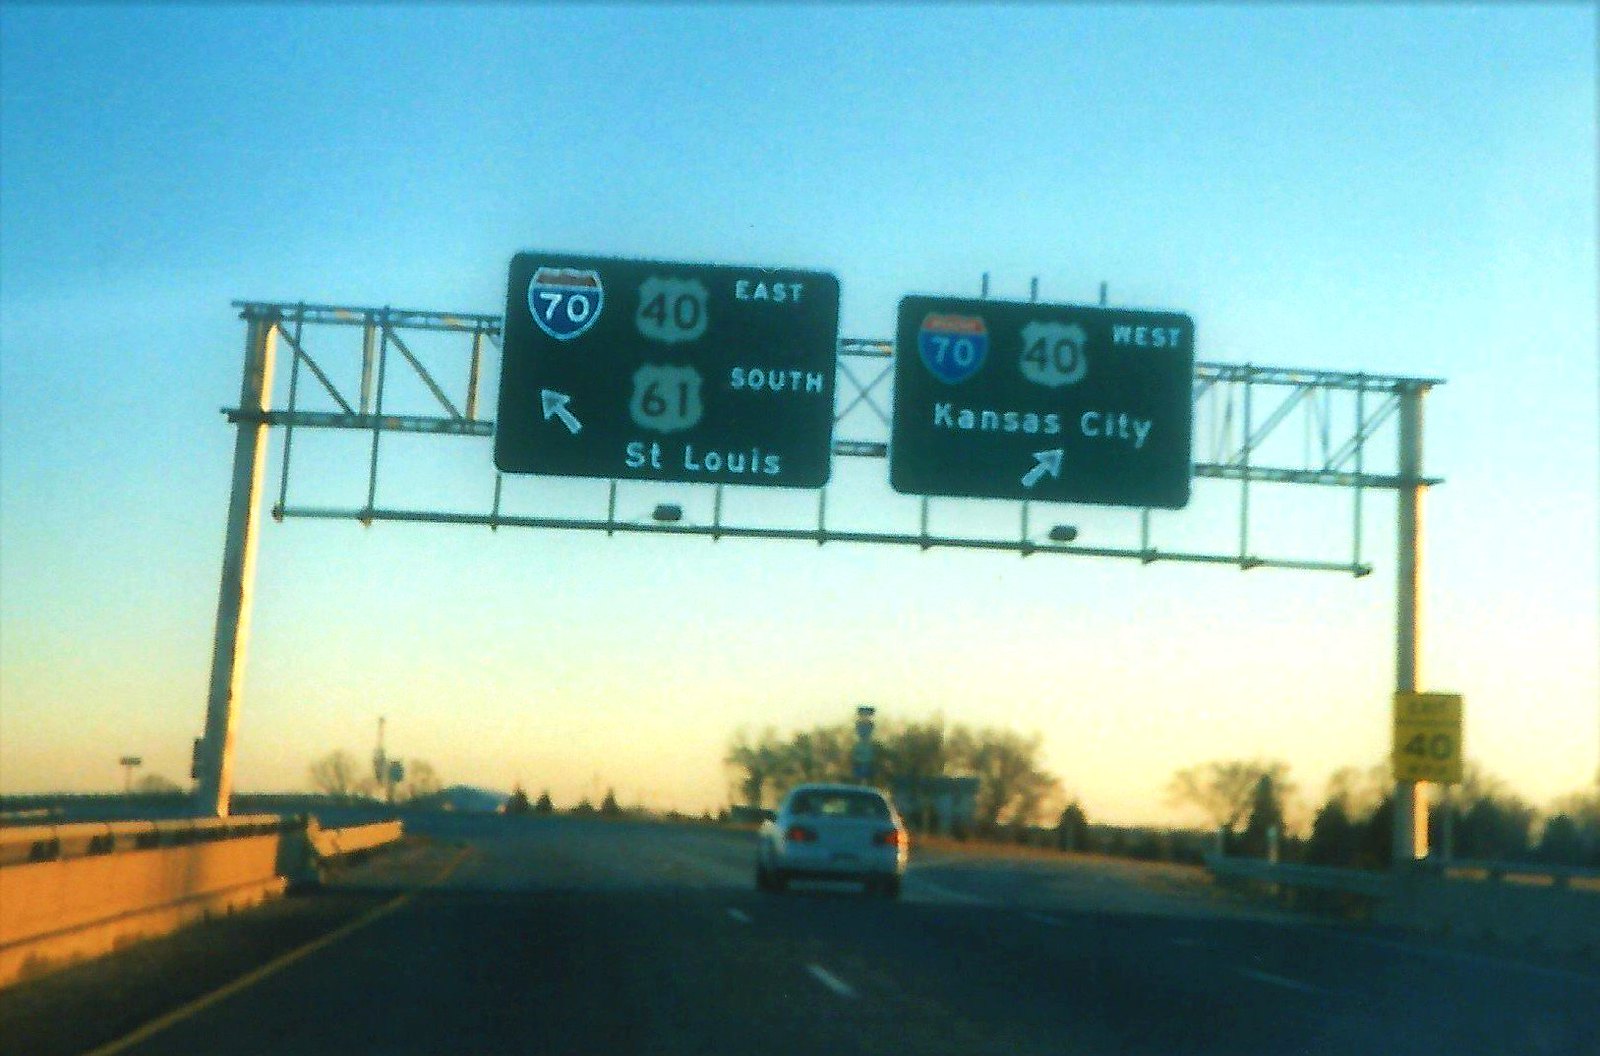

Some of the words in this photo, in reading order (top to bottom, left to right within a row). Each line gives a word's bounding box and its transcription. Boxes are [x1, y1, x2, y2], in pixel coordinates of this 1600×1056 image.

[735, 280, 804, 303] EAST
[539, 293, 590, 322] 70
[640, 294, 698, 330] 40
[930, 336, 974, 366] 70
[1112, 324, 1182, 348] WEST
[1025, 337, 1078, 375] 40
[731, 367, 824, 394] SOUTH
[641, 383, 688, 417] 61
[934, 402, 1061, 434] Kansas
[1080, 411, 1152, 448] City
[625, 442, 662, 469] St
[685, 445, 782, 475] Louis
[1403, 732, 1452, 760] 40
